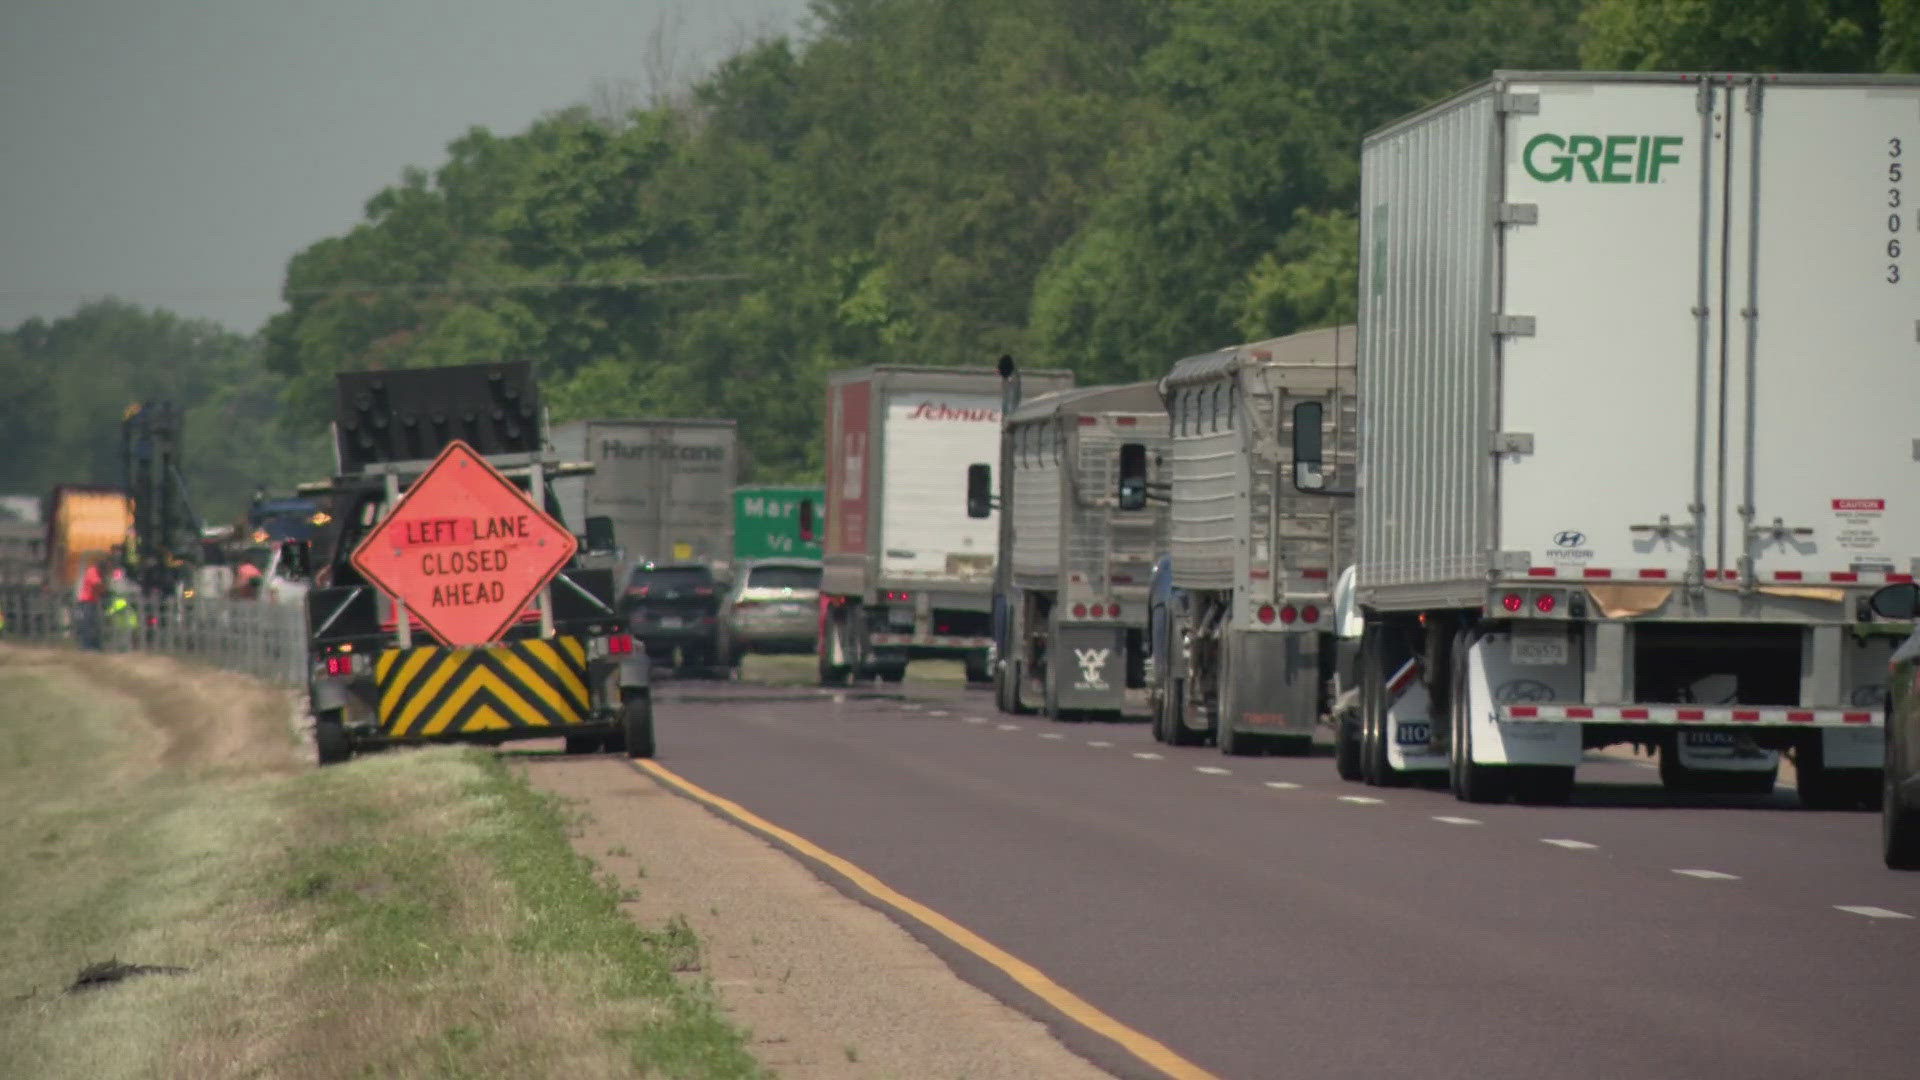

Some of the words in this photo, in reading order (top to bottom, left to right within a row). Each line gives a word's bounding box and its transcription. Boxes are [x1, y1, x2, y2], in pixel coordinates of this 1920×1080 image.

[1523, 133, 1684, 183] GREIF
[1886, 137, 1902, 284] 353063
[406, 519, 457, 544] LEFT
[473, 515, 530, 540] LANE
[422, 549, 508, 576] CLOSED
[432, 581, 505, 608] AHEAD
